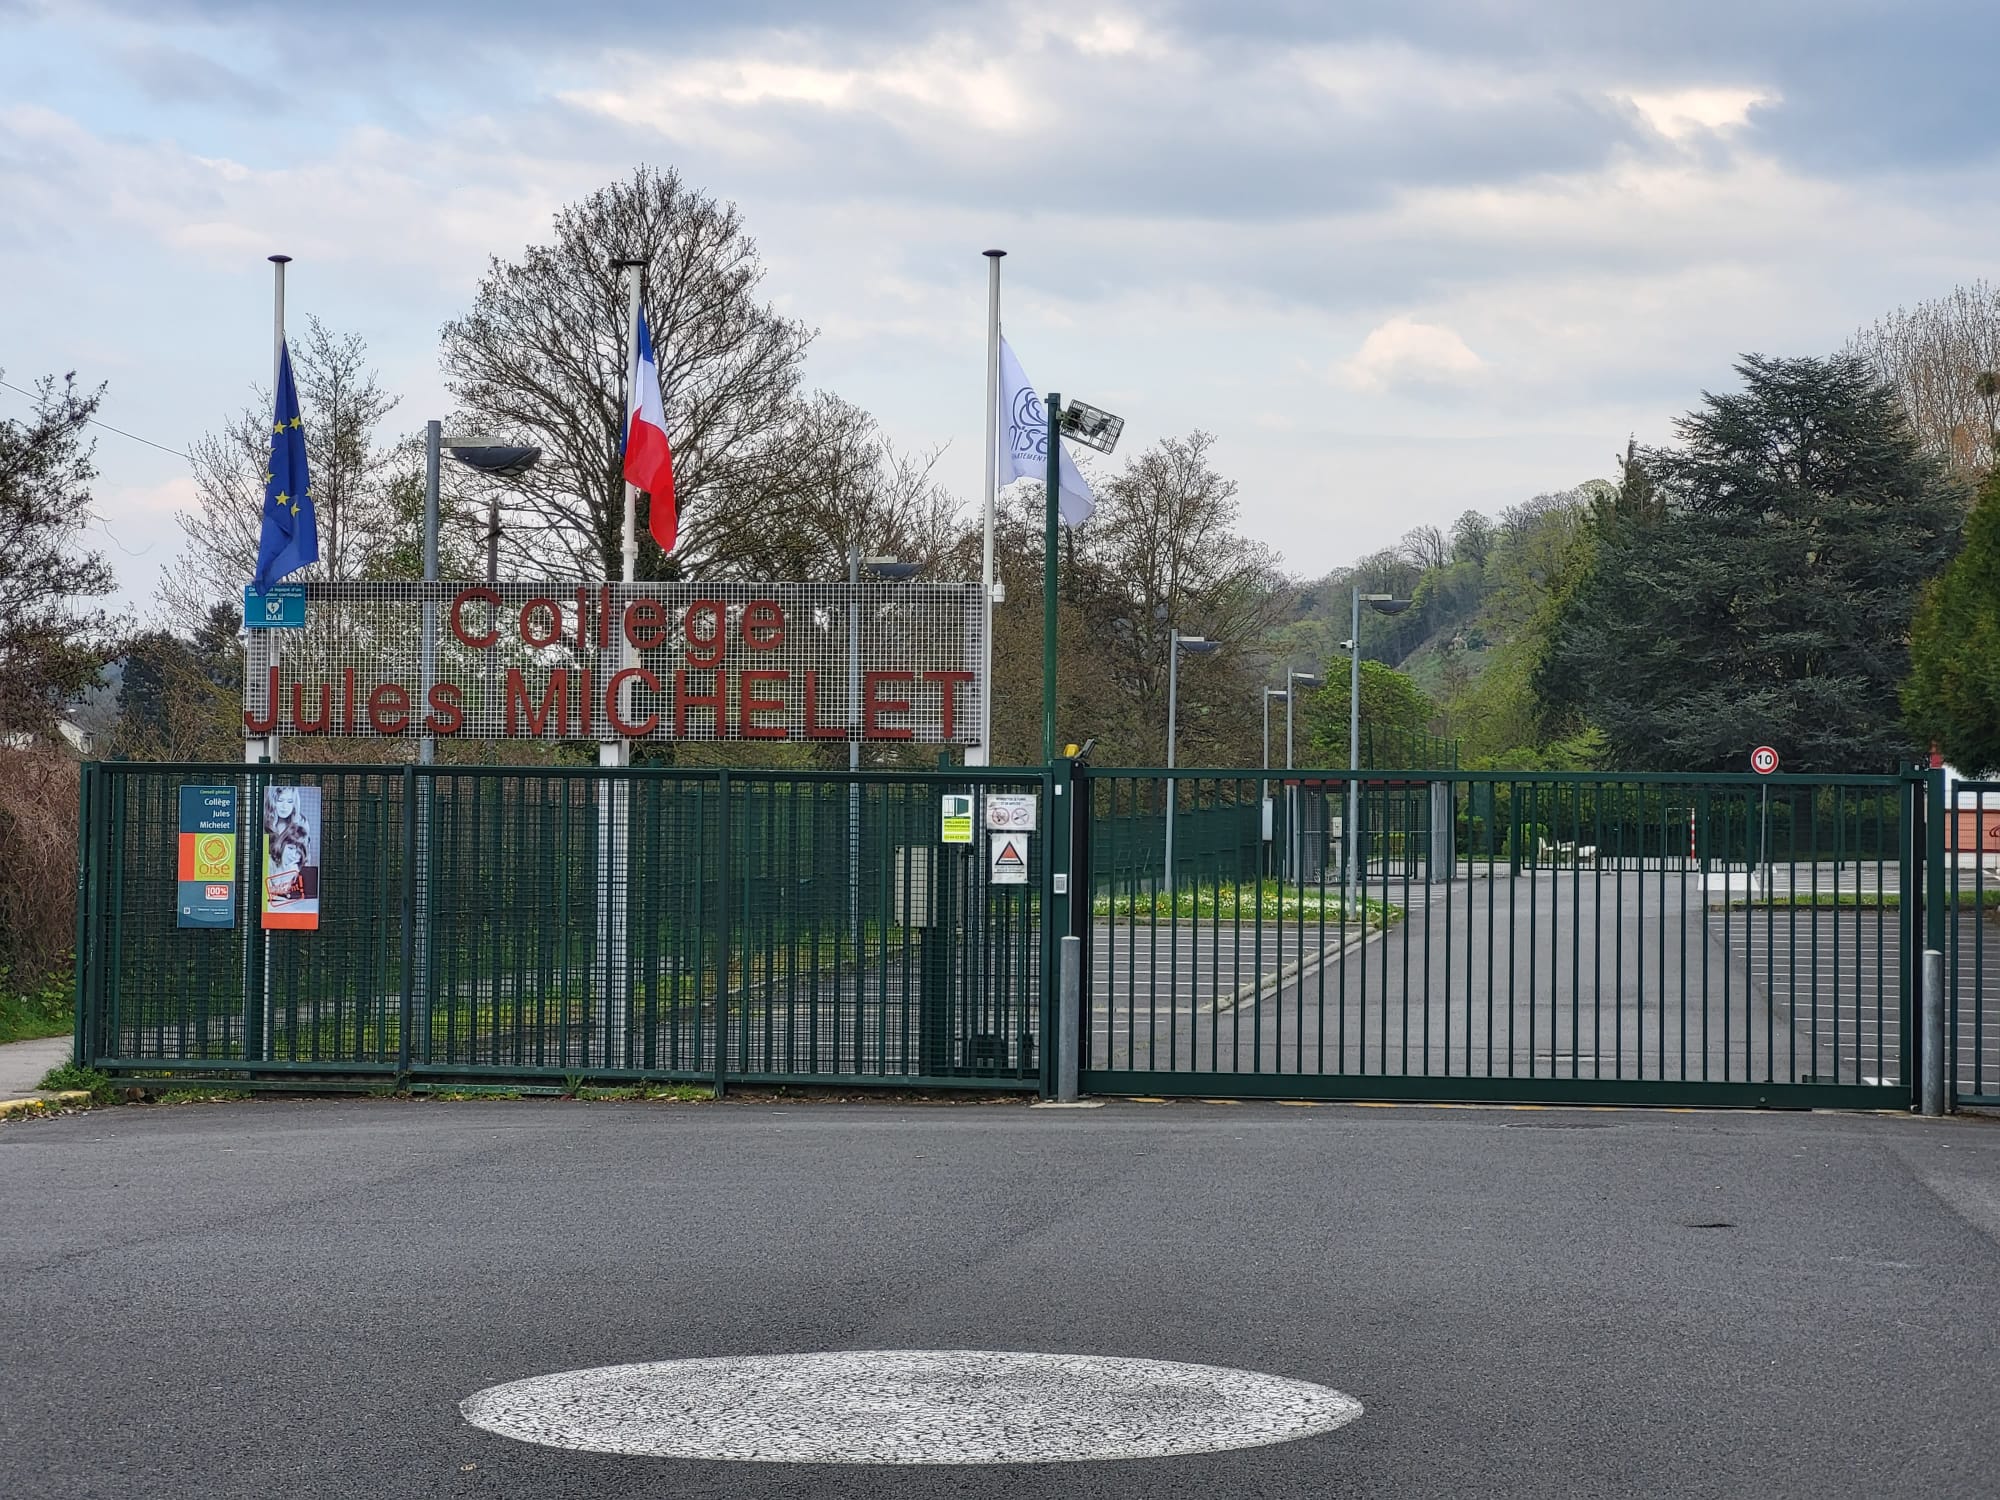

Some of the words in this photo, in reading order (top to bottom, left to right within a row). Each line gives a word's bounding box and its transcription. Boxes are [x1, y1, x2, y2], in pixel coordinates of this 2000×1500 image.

[451, 587, 785, 668] College
[244, 665, 464, 734] Jules
[506, 667, 975, 738] MICHELET
[1757, 754, 1773, 766] 10
[204, 798, 230, 807] Collège
[213, 810, 230, 818] Jules
[200, 821, 230, 829] Michelet
[199, 863, 230, 875] oise
